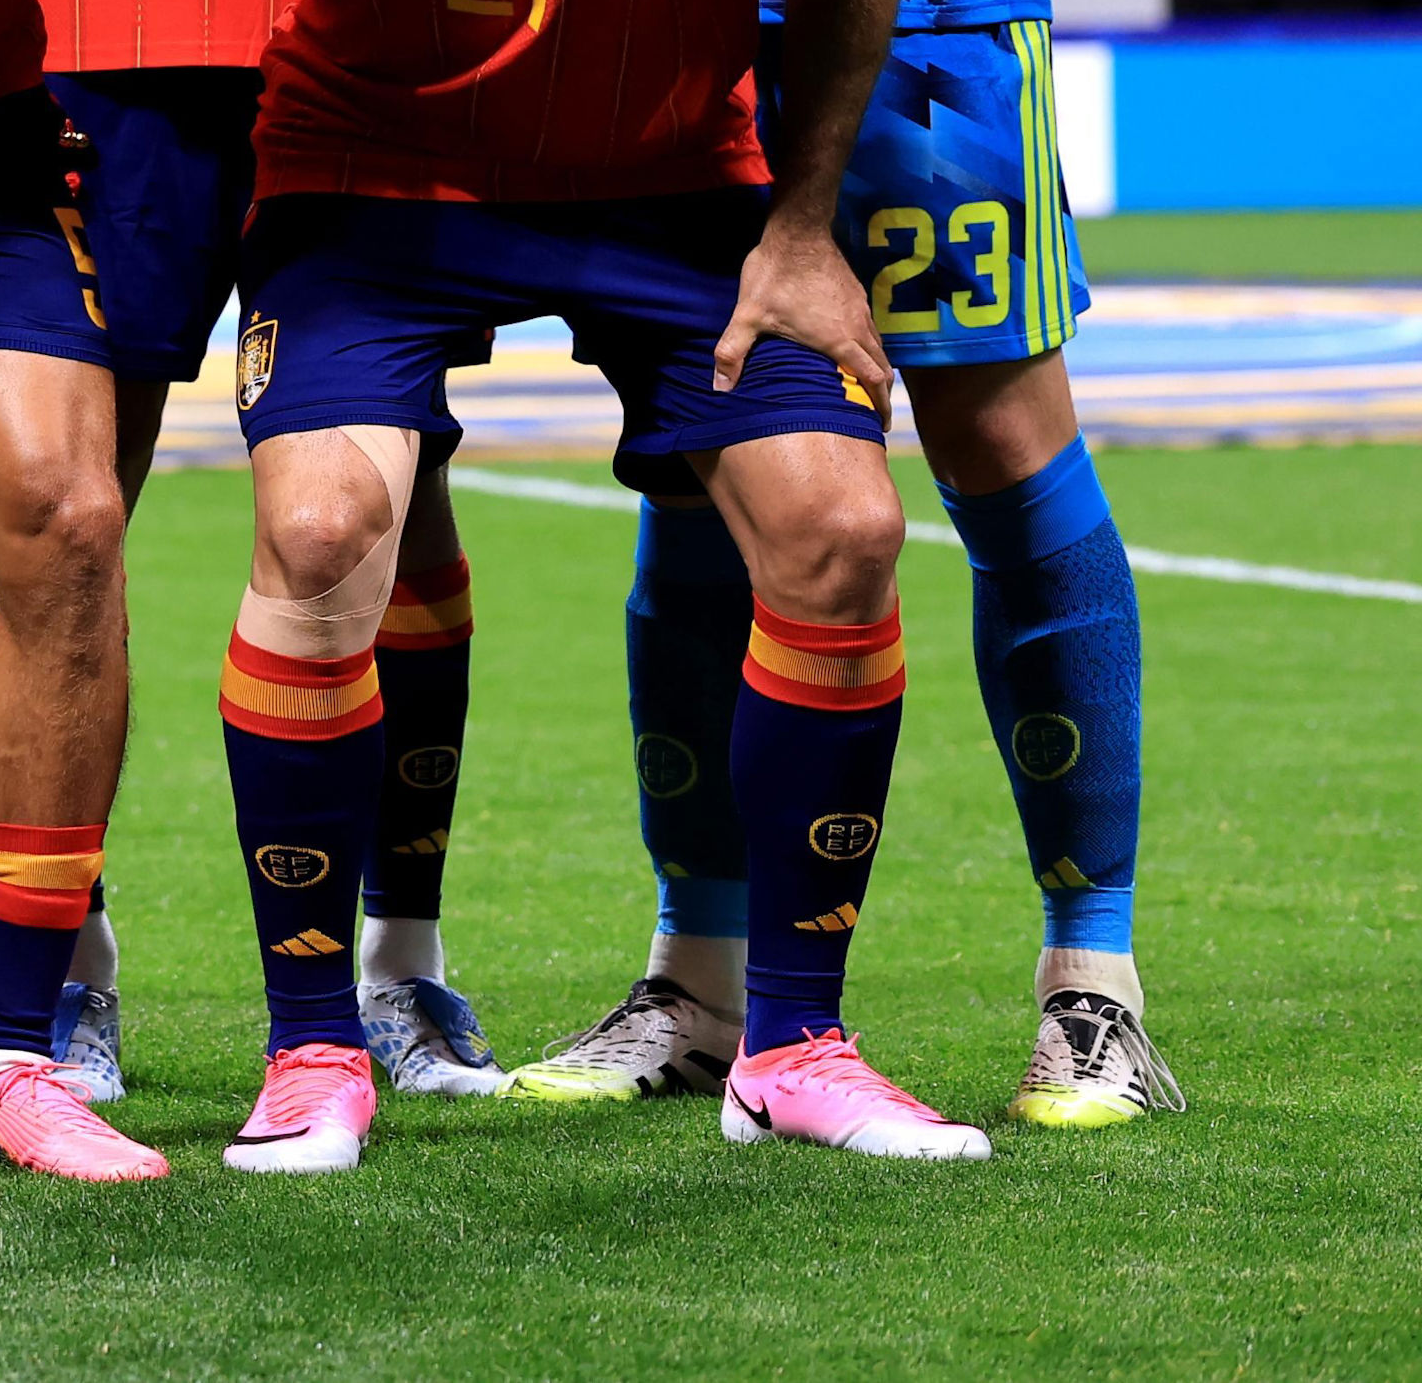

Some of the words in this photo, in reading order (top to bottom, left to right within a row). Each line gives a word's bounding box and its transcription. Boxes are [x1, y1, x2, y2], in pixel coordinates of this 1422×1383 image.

[867, 200, 1011, 334] 23
[827, 823, 865, 837] RF
[826, 838, 863, 851] EF
[269, 852, 309, 866] RF
[271, 866, 309, 878] EF
